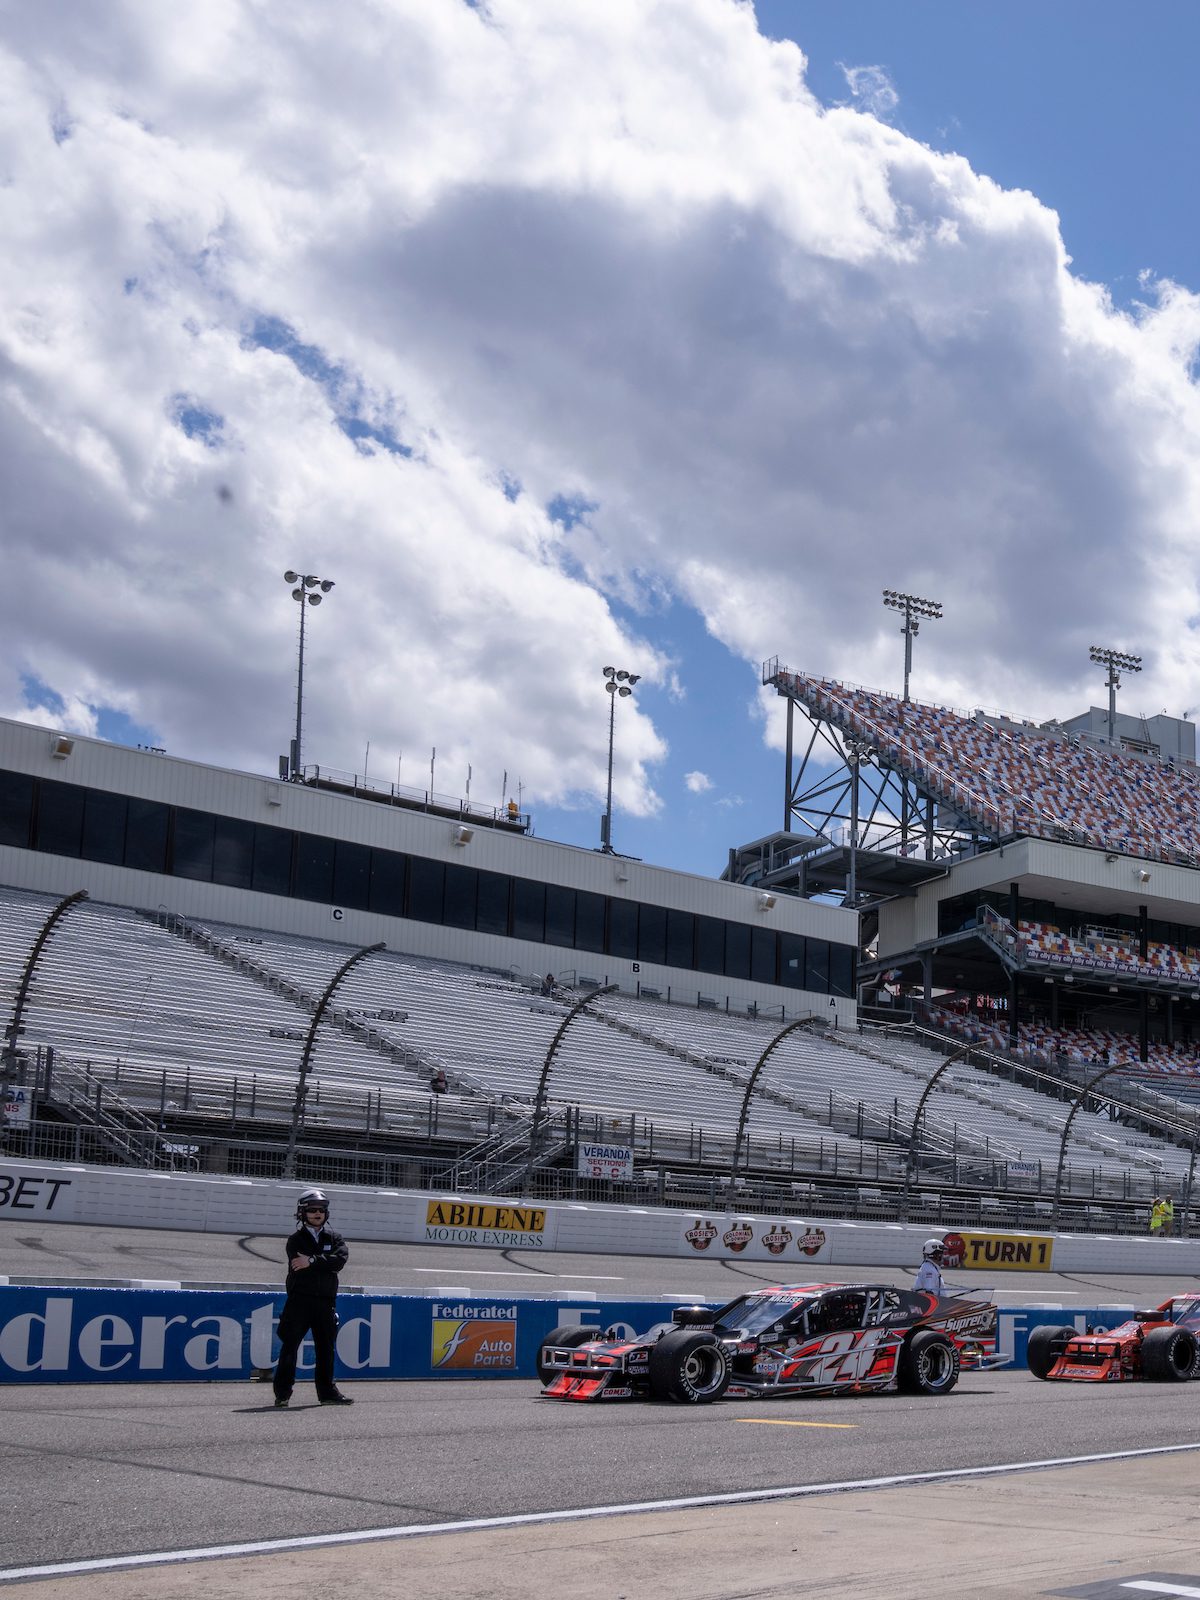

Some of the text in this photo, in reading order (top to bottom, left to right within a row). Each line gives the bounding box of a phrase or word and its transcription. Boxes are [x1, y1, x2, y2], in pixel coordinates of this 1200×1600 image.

[333, 909, 343, 920] C
[632, 962, 640, 973] B
[829, 997, 836, 1007] A
[583, 1146, 630, 1160] VERANDA
[587, 1158, 627, 1167] SECTIONS
[429, 1203, 544, 1231] ABILENE
[424, 1227, 543, 1247] MOTOR EXPRESS
[689, 1230, 715, 1238] ROSIE'S
[725, 1230, 750, 1240] COLONIAL
[765, 1234, 789, 1242] ROSIE'S
[800, 1235, 823, 1244] COLONIAL
[970, 1240, 1047, 1263] TURN 1
[432, 1304, 517, 1319] Federated
[479, 1340, 512, 1352] Auto
[473, 1353, 512, 1366] Parts
[713, 1336, 733, 1372] Hoosier
[805, 1328, 885, 1383] 24
[679, 1367, 701, 1402] Hoosier
